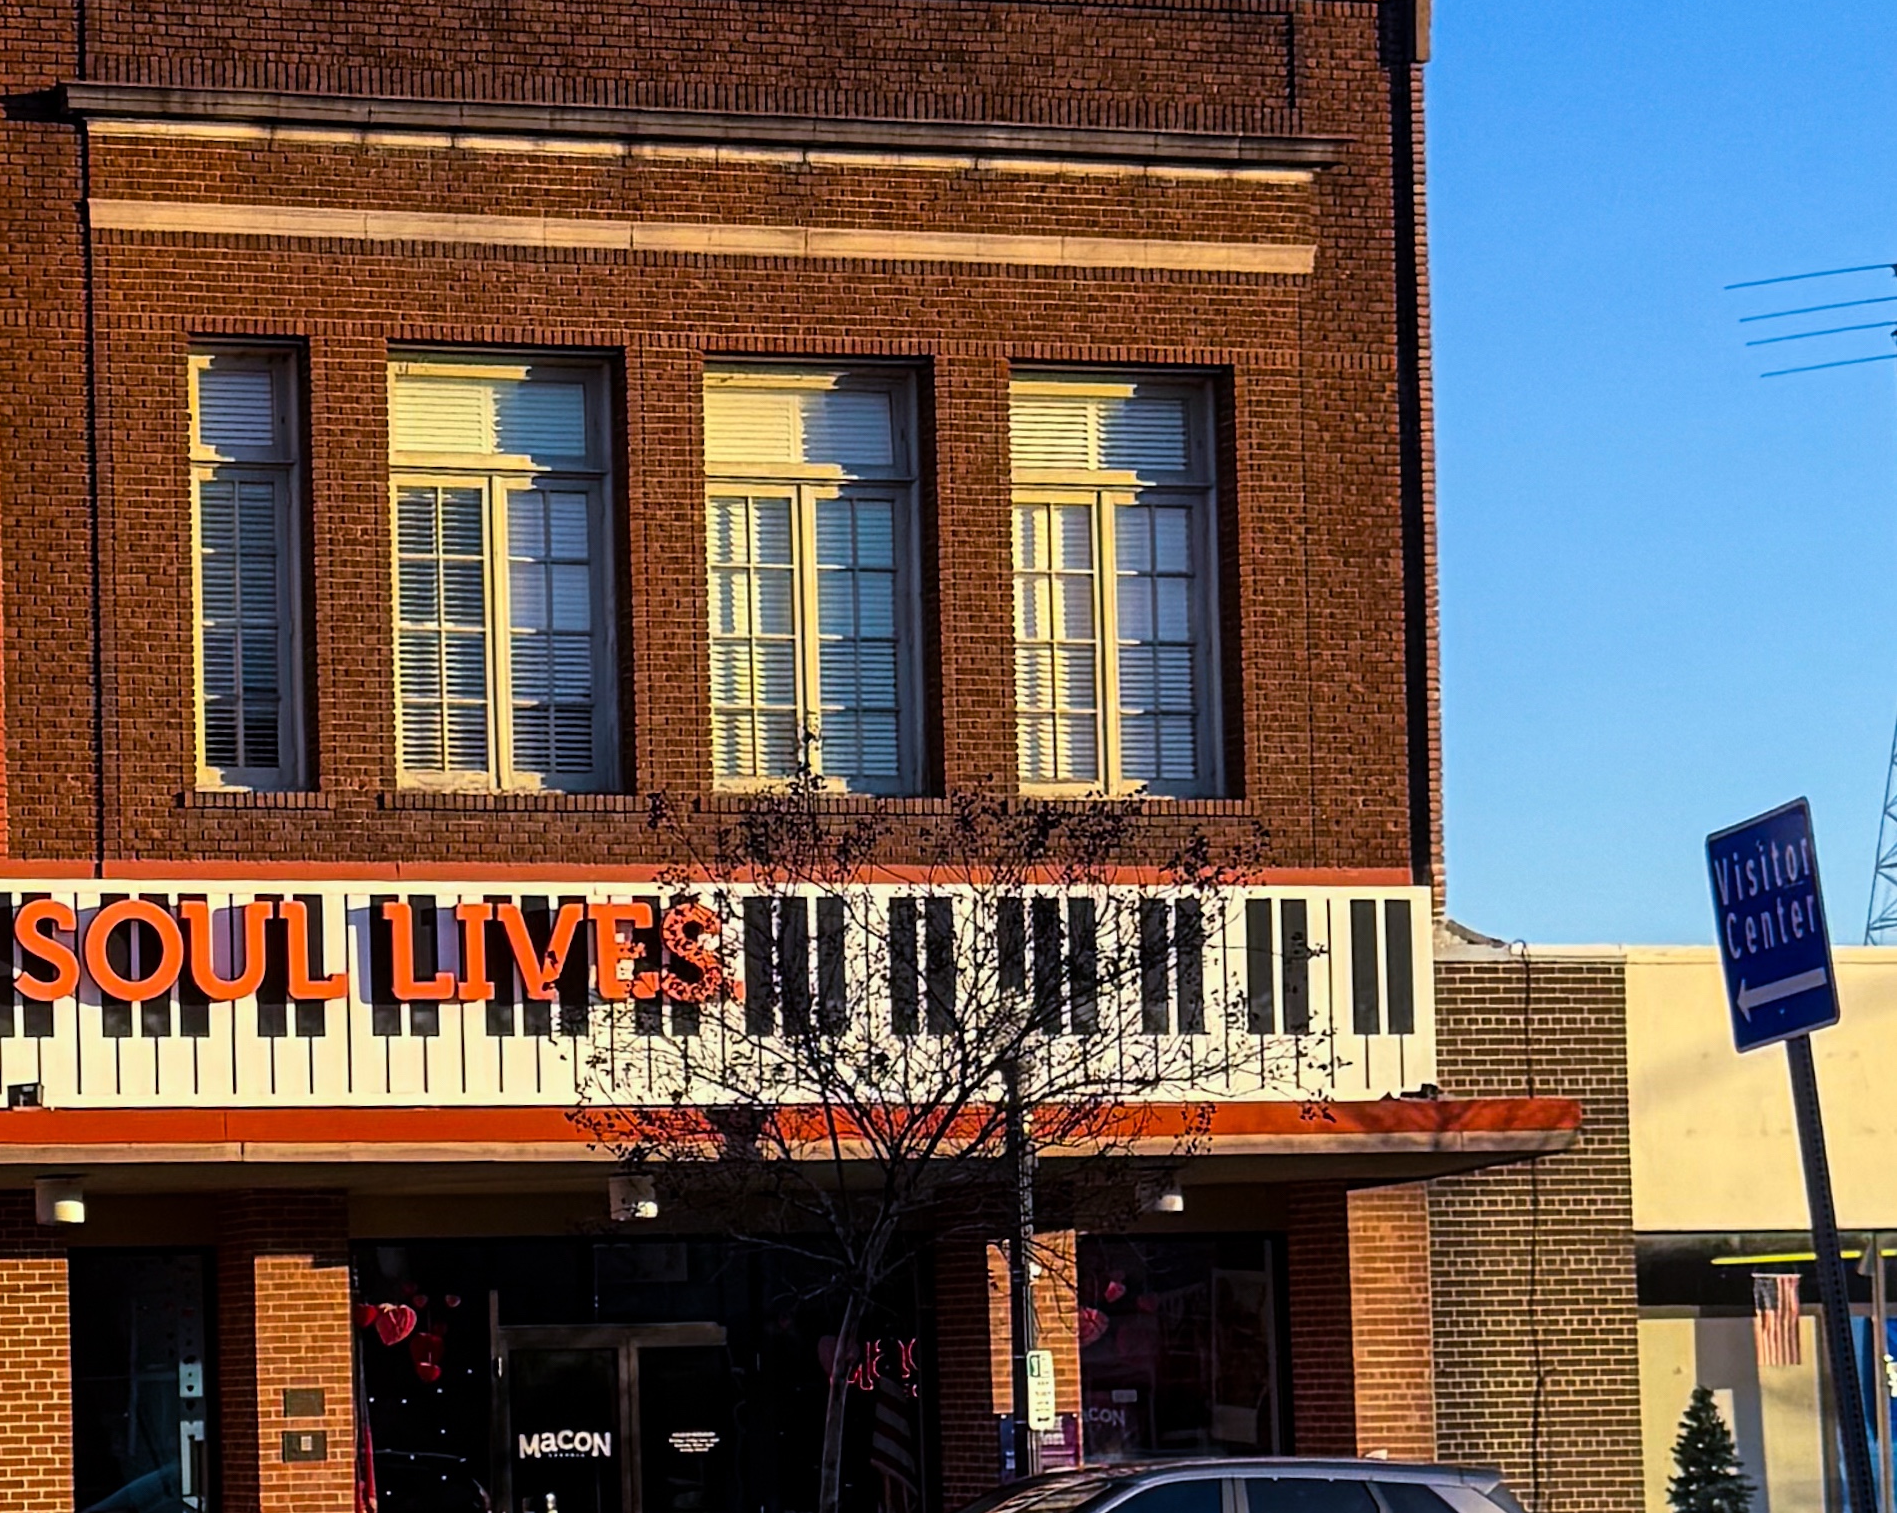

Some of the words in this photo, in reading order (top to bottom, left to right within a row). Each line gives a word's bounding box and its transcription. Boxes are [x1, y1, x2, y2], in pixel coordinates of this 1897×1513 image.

[1713, 836, 1811, 907] Visitor
[13, 899, 349, 1002] SOUL
[382, 900, 722, 1003] LIVES
[1725, 892, 1816, 961] Center
